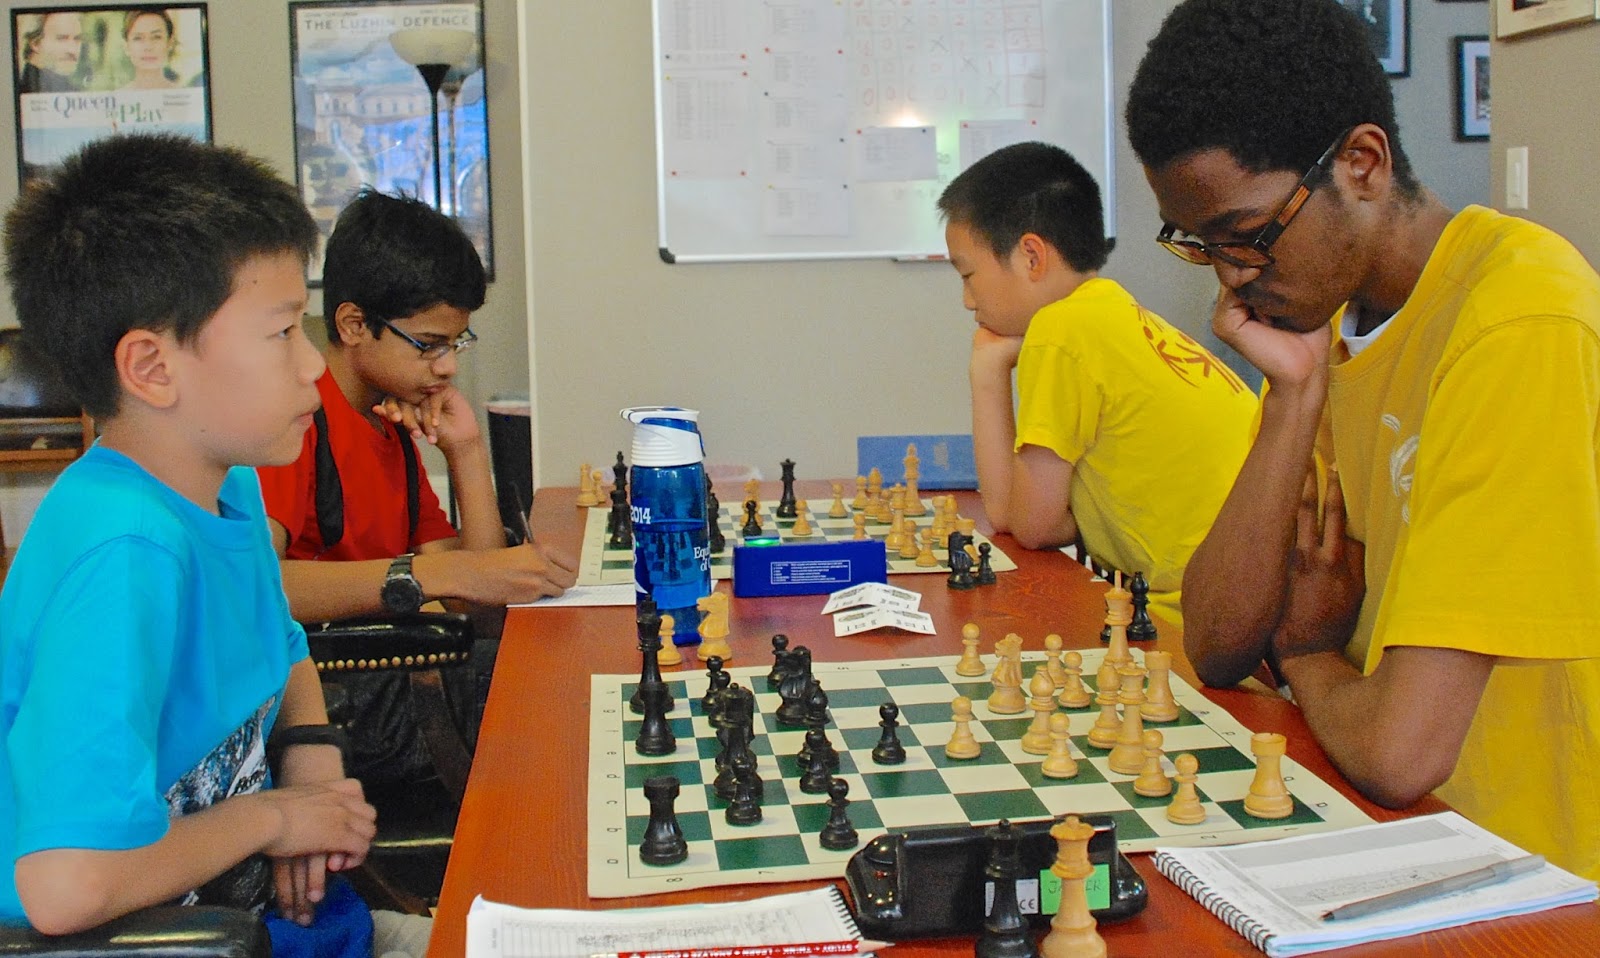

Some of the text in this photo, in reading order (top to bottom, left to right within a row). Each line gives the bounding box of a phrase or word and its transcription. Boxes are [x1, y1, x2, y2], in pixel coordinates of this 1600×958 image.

[305, 14, 470, 30] THE LUZHIN DEFENCE
[53, 95, 116, 118] Queen
[630, 505, 651, 525] 2014
[1019, 898, 1036, 911] CE
[741, 947, 773, 957] LEARN
[782, 945, 813, 955] THINK
[822, 943, 853, 953] STUDY
